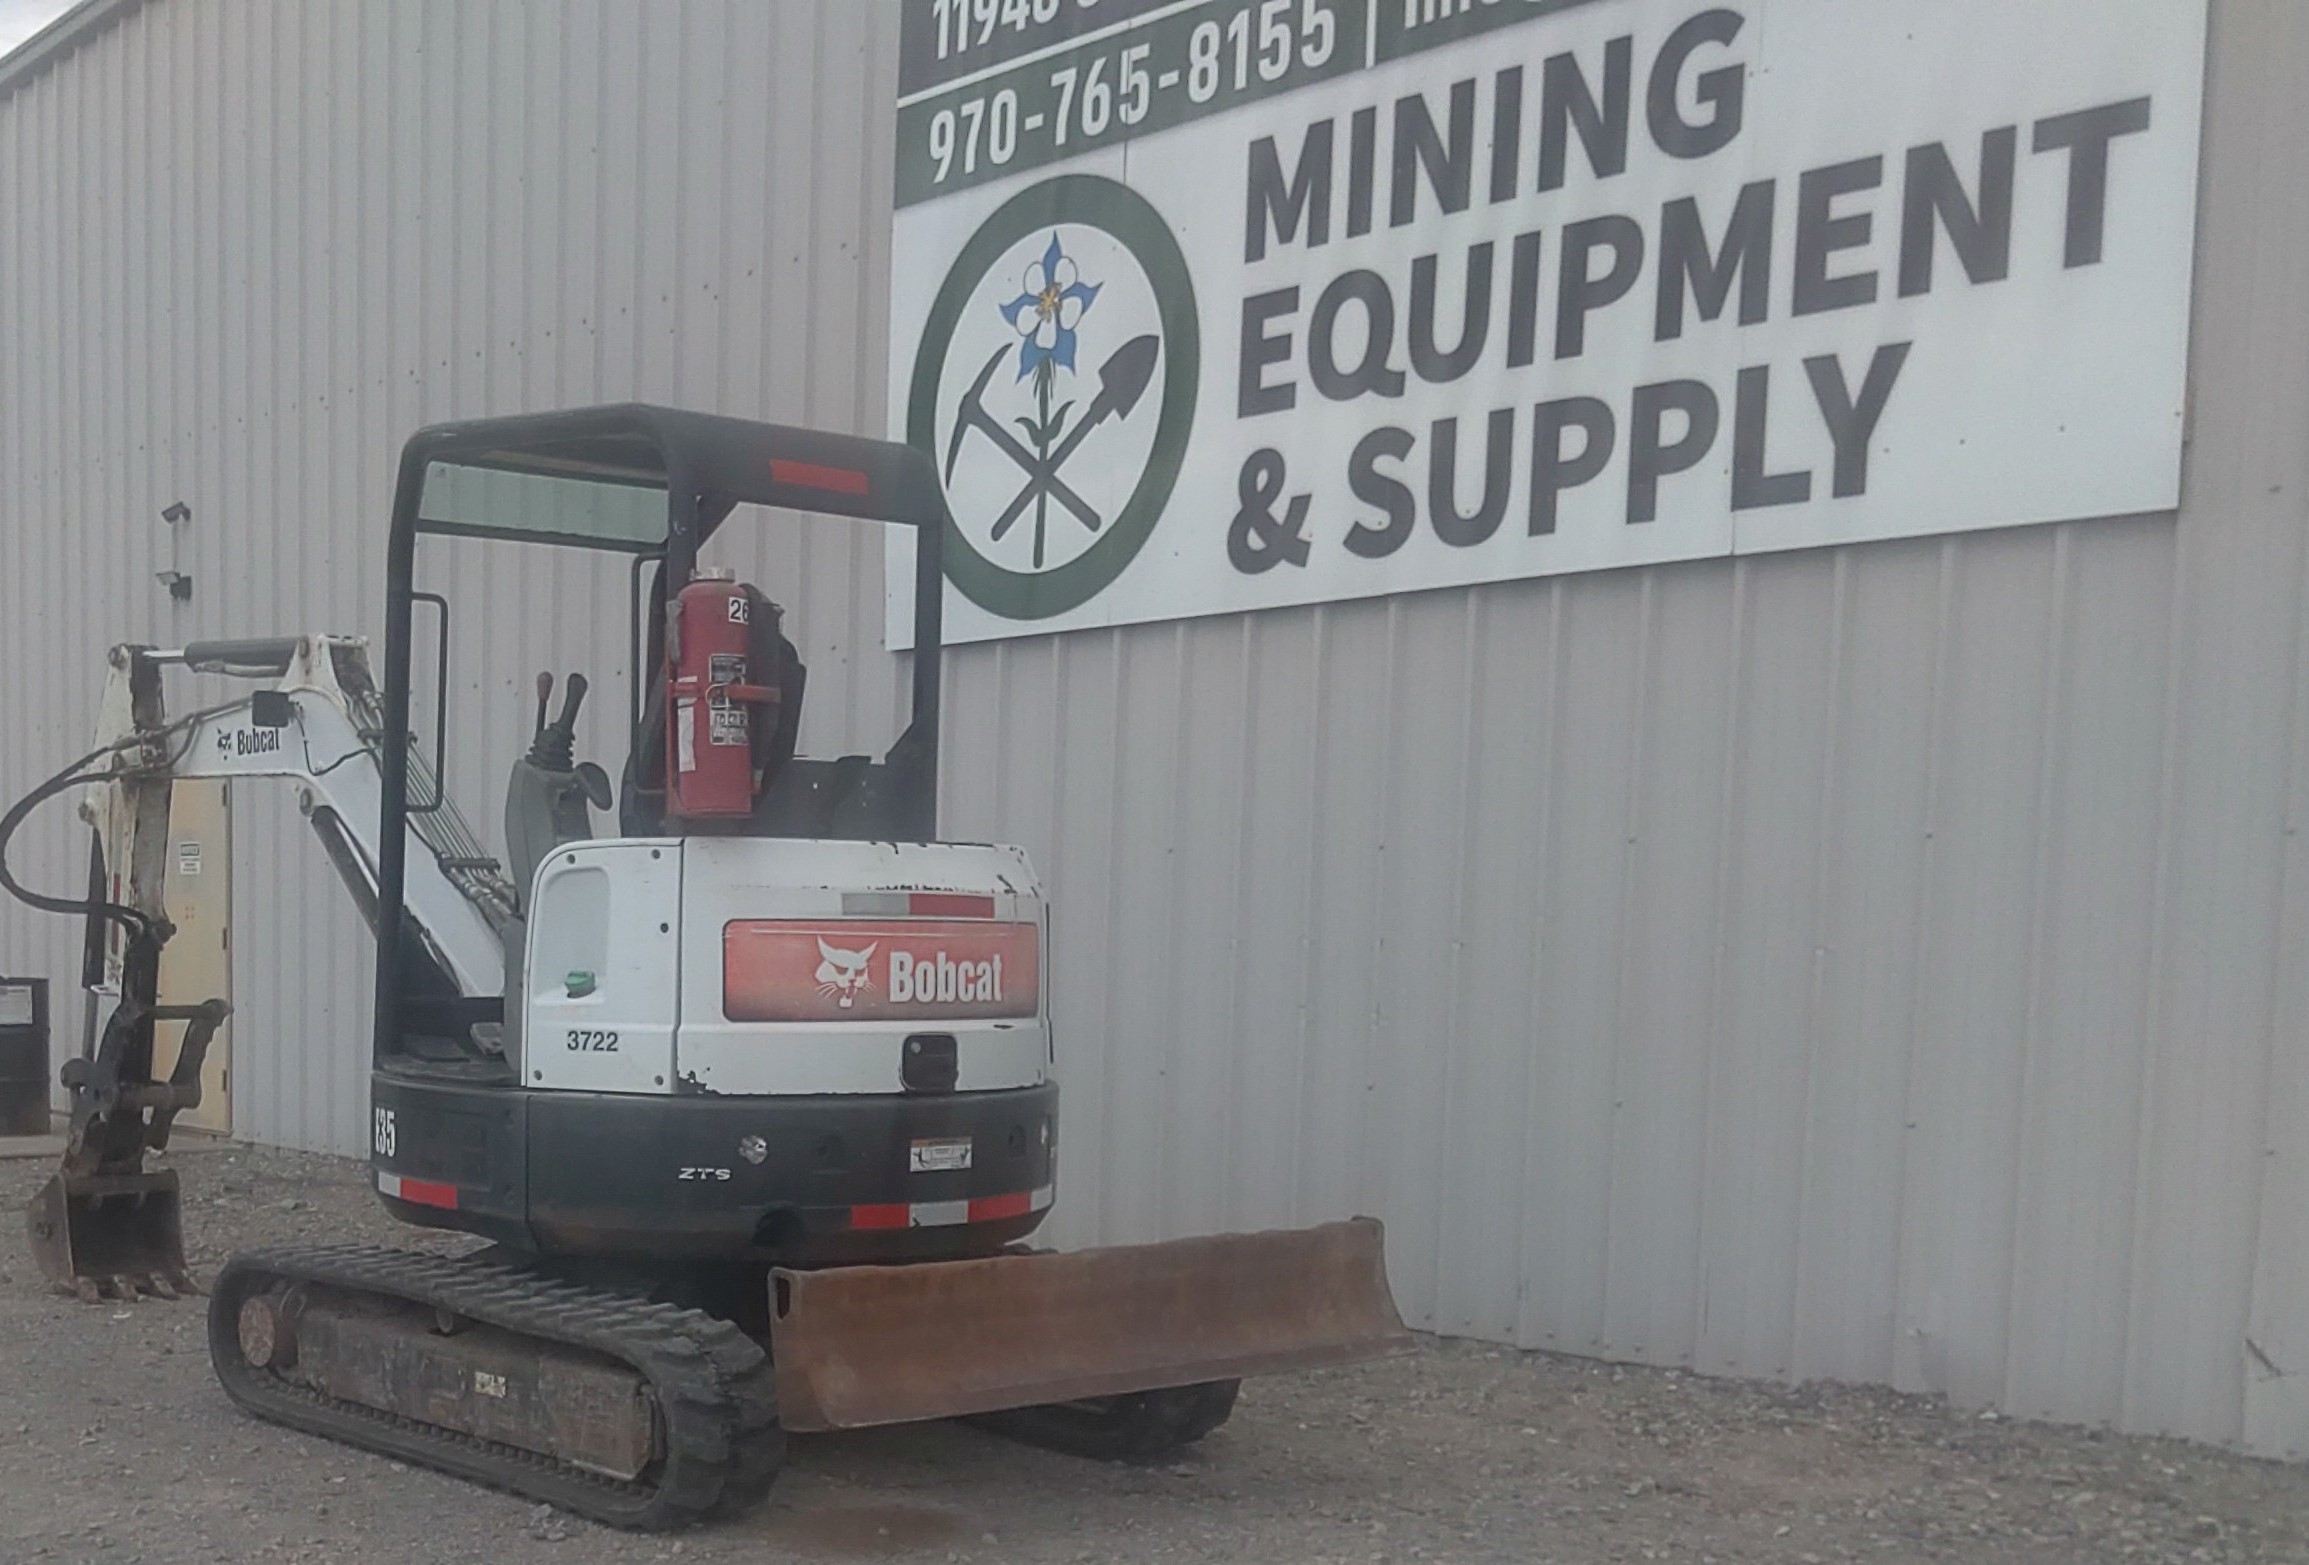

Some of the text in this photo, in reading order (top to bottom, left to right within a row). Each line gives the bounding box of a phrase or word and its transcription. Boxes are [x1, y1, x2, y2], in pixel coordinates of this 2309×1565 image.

[1244, 9, 1746, 264] MINING
[1237, 95, 2152, 419] EQUIPMENT
[1226, 341, 1913, 576] & SUPPLY
[237, 728, 280, 756] Bobcat
[889, 951, 1003, 1003] Bobcat
[567, 1031, 619, 1052] 3722
[678, 1168, 732, 1180] ZTS
